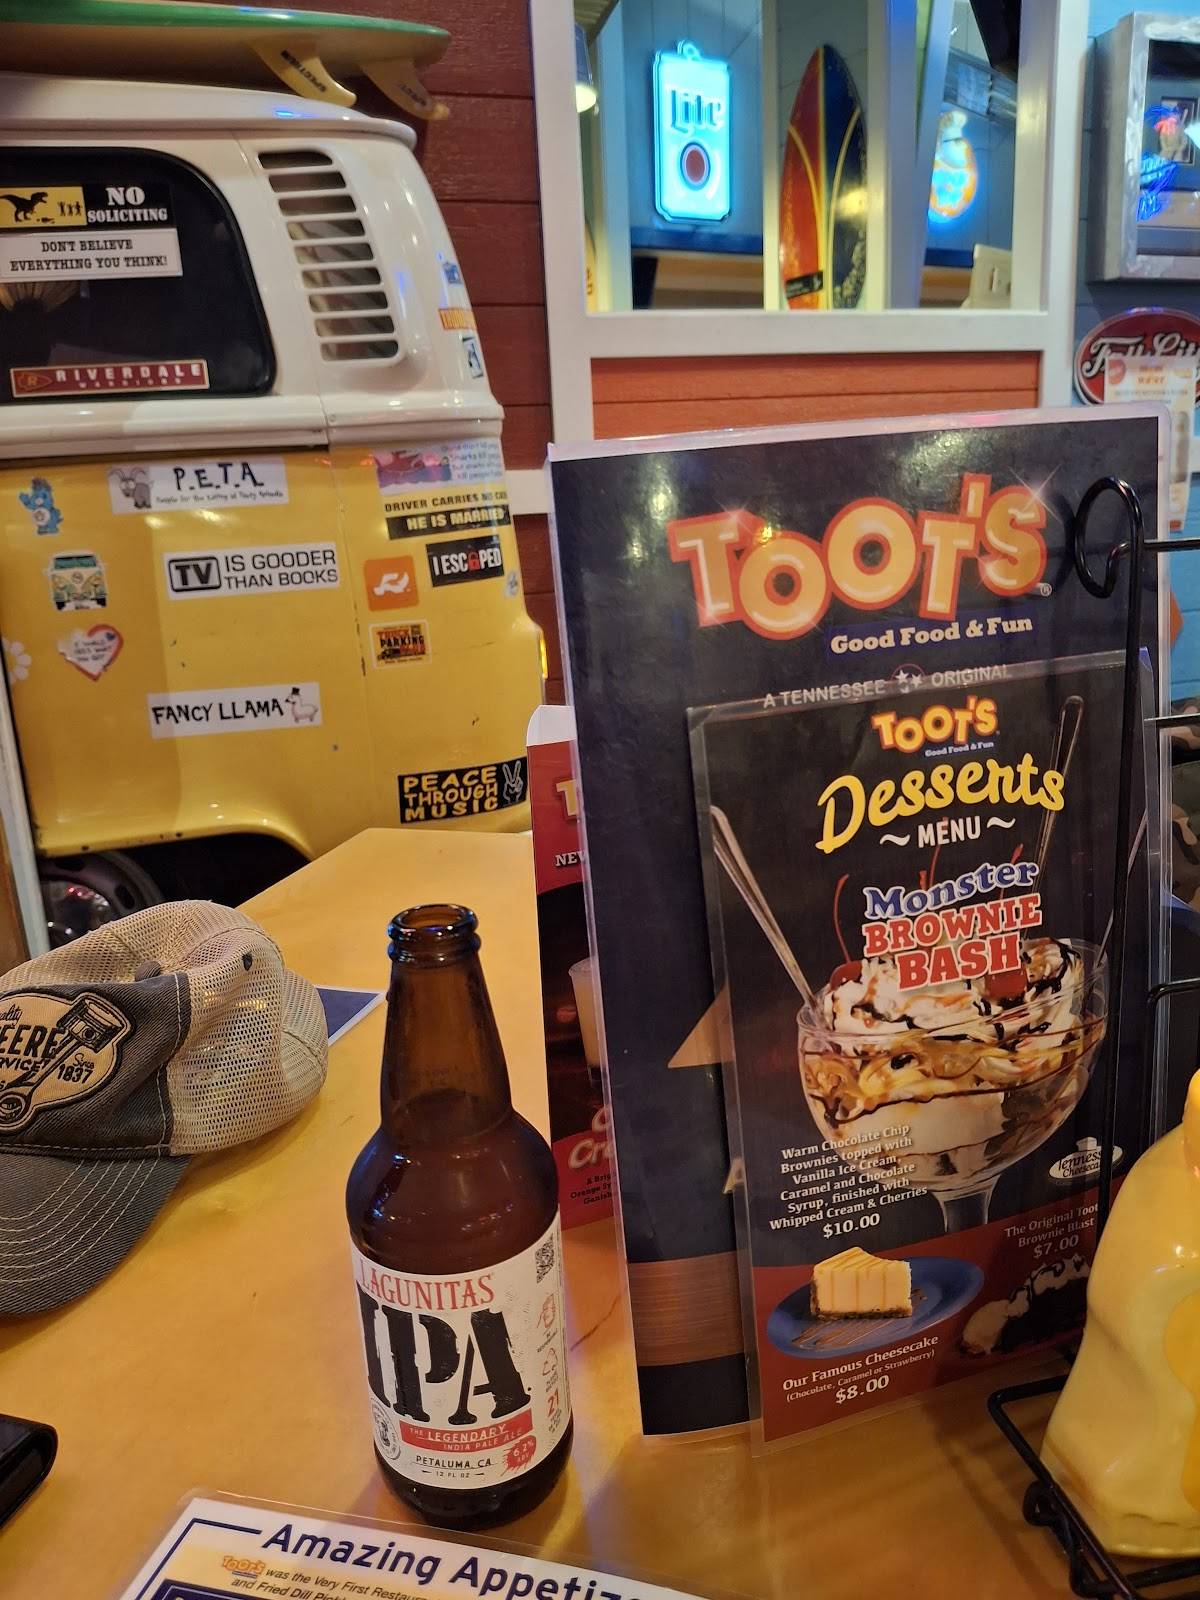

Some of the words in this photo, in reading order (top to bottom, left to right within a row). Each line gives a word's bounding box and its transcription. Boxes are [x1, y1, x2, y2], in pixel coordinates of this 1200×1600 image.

[671, 87, 724, 134] Lite
[105, 186, 146, 206] NO
[87, 207, 168, 223] SOLICITING
[40, 240, 76, 253] DON'T
[79, 239, 134, 251] BELIEVE
[10, 257, 93, 272] EVERYTHING
[95, 256, 121, 269] YOU
[124, 255, 168, 268] THINK!
[55, 363, 201, 382] RIVERDALE
[384, 500, 428, 512] DRIVER
[431, 493, 479, 507] CARRIES
[406, 517, 428, 531] HE
[430, 513, 447, 528] IS
[450, 507, 505, 526] MARRIED
[224, 555, 245, 572] IS
[252, 549, 336, 570] GOODER
[432, 555, 440, 576] I
[666, 472, 1048, 641] TOOT'S
[175, 562, 212, 586] TV
[224, 574, 273, 590] THAN
[278, 568, 338, 586] BOOKS
[830, 629, 896, 655] Good
[899, 621, 960, 647] Food
[964, 619, 985, 639] &
[986, 614, 1033, 637] Fun
[762, 692, 777, 709] A
[779, 679, 887, 706] TENNESSEE
[930, 664, 1014, 687] ORIGINAL
[151, 703, 213, 725] FANCY
[219, 698, 284, 720] LLAMA
[870, 694, 998, 754] TOOT'S
[925, 745, 947, 757] Good
[948, 743, 969, 754] Food
[978, 741, 994, 750] Fun
[403, 765, 497, 793] PEACE
[404, 782, 498, 807] THROUGH
[815, 752, 1065, 854] Desserts
[405, 796, 498, 821] MUSIC
[917, 815, 981, 848] MENU
[862, 861, 1039, 920] Monster
[862, 892, 1043, 957] BROWNIE
[896, 931, 1022, 991] BASH
[57, 1063, 93, 1083] 1837
[782, 1145, 819, 1160] Warm
[821, 1132, 881, 1151] Chocolate
[882, 1124, 910, 1139] Chip
[780, 1155, 839, 1174] Brownies
[841, 1143, 882, 1162] topped
[884, 1137, 912, 1151] with
[1058, 1150, 1101, 1171] Tennes
[780, 1182, 831, 1201] Caramel
[833, 1176, 856, 1190] and
[858, 1163, 916, 1184] Chocolate
[792, 1170, 836, 1185] Vanilla
[838, 1163, 856, 1175] Ice
[1062, 1163, 1100, 1178] Cheeseca
[769, 1206, 824, 1231] Whipped
[826, 1202, 865, 1219] Cream
[867, 1199, 877, 1209] &
[879, 1186, 928, 1206] Cherries
[787, 1197, 829, 1215] Syrup,
[831, 1185, 880, 1205] finished
[882, 1177, 910, 1191] with
[822, 1212, 881, 1239] $10.00
[1004, 1225, 1027, 1238] The
[1028, 1210, 1074, 1232] Original
[1076, 1201, 1099, 1217] Toot
[1018, 1226, 1065, 1248] Brownie
[1033, 1234, 1079, 1259] $7.00
[359, 1258, 496, 1311] LAGUNITAS
[783, 1376, 809, 1391] Our
[811, 1361, 863, 1383] Famous
[865, 1335, 939, 1366] Cheesecake
[837, 1368, 873, 1387] Caramel
[873, 1366, 883, 1375] or
[884, 1349, 935, 1372] Strawberry)
[835, 1374, 890, 1405] $8.00
[427, 1423, 508, 1443] LEGENDARY
[443, 1442, 471, 1451] INDIA
[475, 1439, 499, 1449] PALE
[477, 1457, 492, 1467] CA
[261, 1523, 442, 1585] Amazing
[448, 1555, 640, 1600] Appeti
[231, 1576, 256, 1589] and
[256, 1581, 290, 1597] Fried
[289, 1586, 313, 1600] Dill
[266, 1569, 290, 1580] was
[291, 1570, 311, 1584] the
[313, 1575, 339, 1591] Very
[341, 1580, 371, 1595] First
